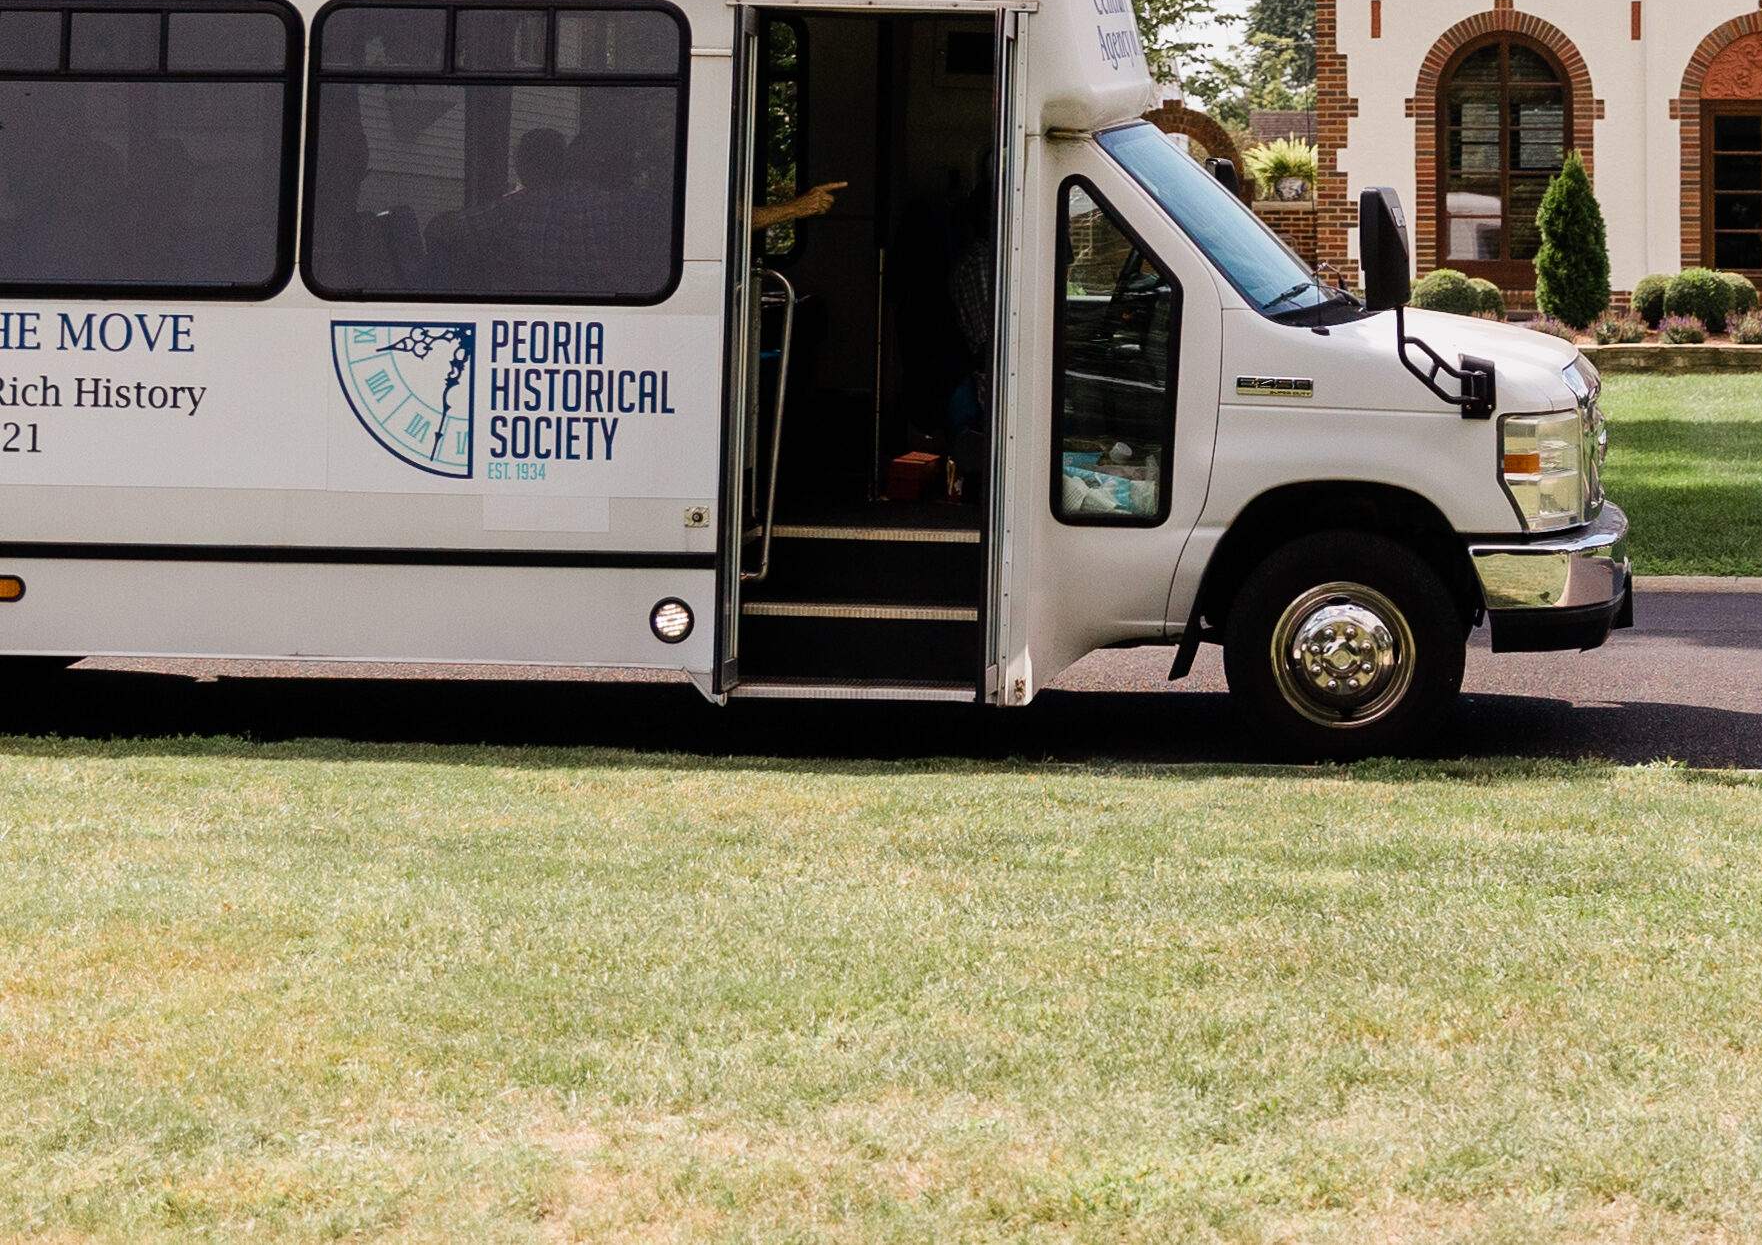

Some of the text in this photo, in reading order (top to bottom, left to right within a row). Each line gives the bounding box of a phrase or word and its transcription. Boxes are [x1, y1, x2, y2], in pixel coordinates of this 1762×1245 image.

[56, 312, 195, 352] MOVE
[490, 320, 604, 365] PEORIA
[73, 377, 207, 417] History
[490, 367, 676, 414] HISTORICAL
[2, 421, 42, 453] 21
[490, 415, 619, 461] SOCIETY
[488, 462, 546, 481] EST. 1934
